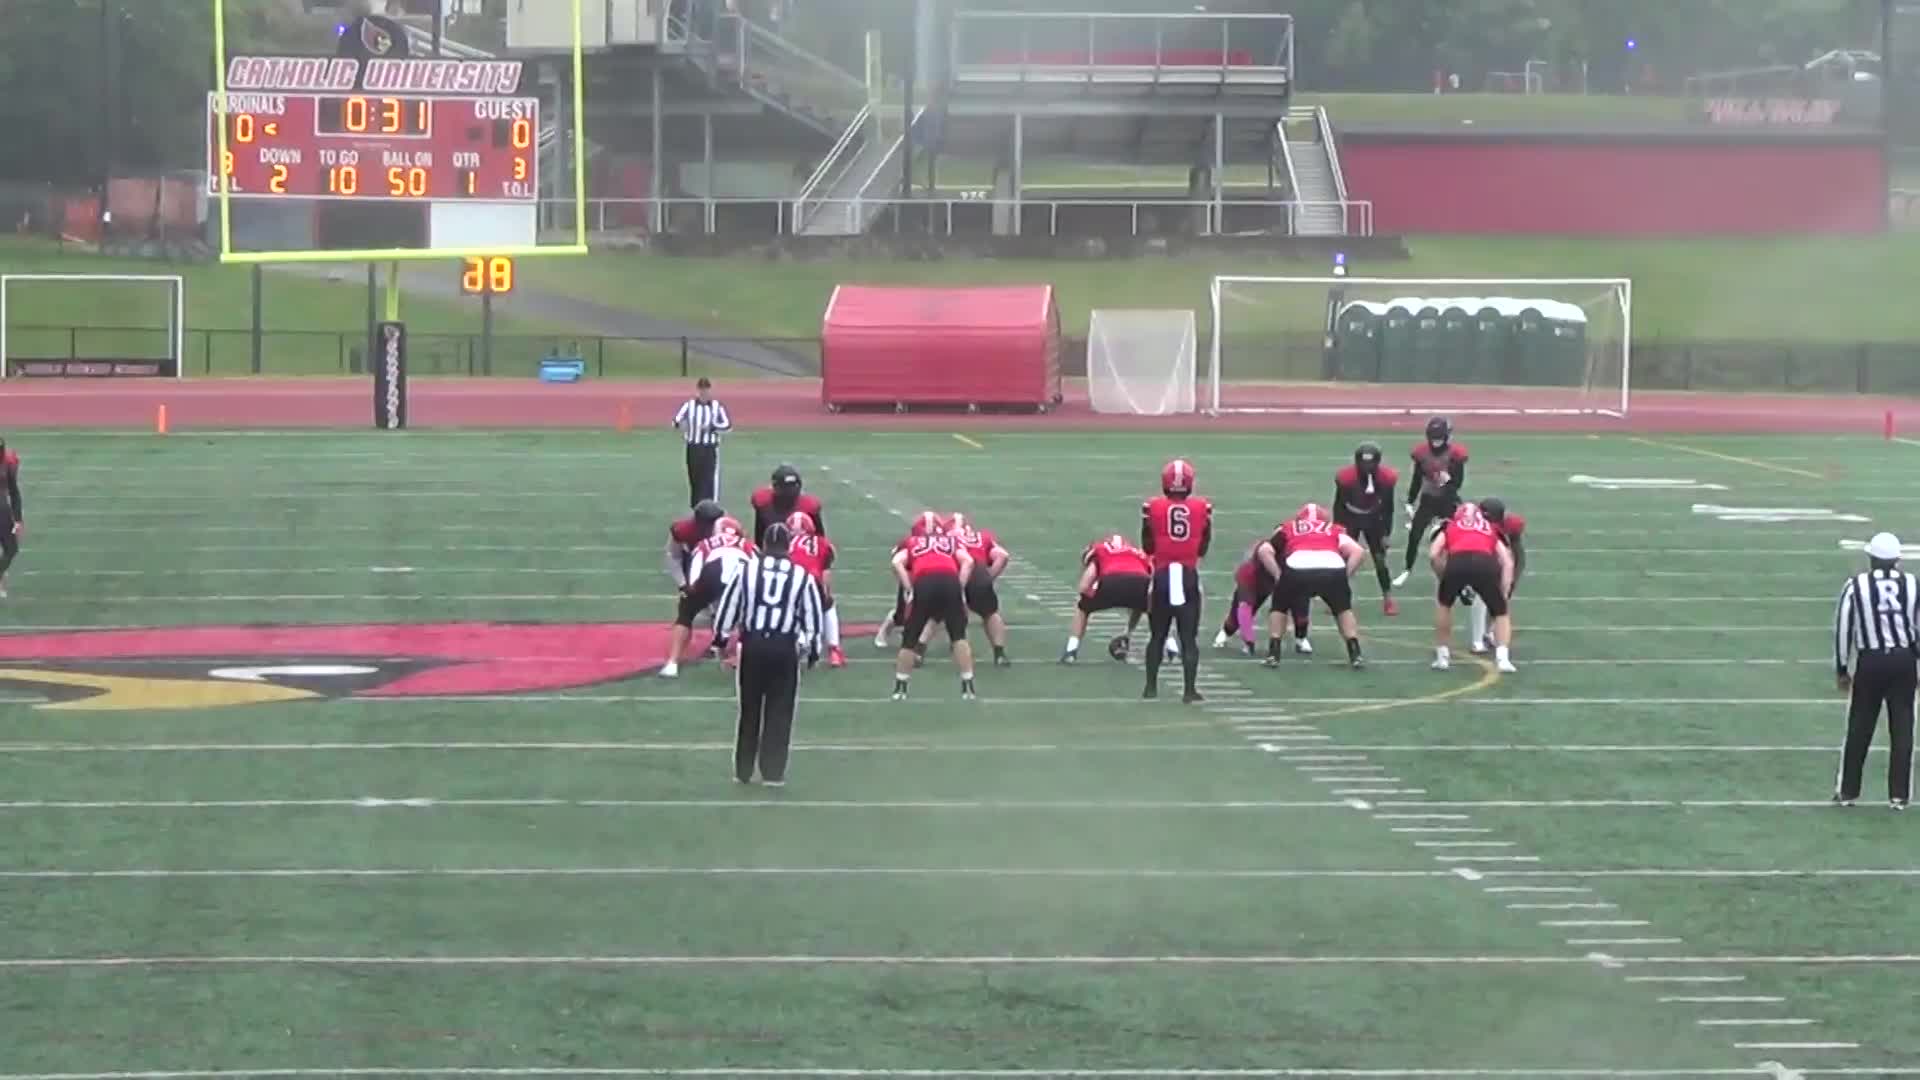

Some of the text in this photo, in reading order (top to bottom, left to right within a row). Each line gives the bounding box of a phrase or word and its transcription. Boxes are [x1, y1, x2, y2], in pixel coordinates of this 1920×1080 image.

[227, 56, 522, 94] CATHOLIC UNIVERSITY
[212, 96, 286, 115] CRDINALS
[474, 100, 534, 120] GUEST
[236, 114, 254, 142] 0
[512, 119, 530, 148] 0
[259, 148, 302, 164] DOWN
[319, 150, 360, 165] TO GO
[382, 151, 433, 167] BALL ON
[452, 152, 480, 168] QTR
[514, 157, 527, 180] 3
[270, 164, 288, 193] 2
[329, 166, 357, 194] 10
[388, 167, 427, 196] 50
[1167, 503, 1191, 542] 6
[761, 571, 790, 606] U
[1875, 579, 1902, 612] R
